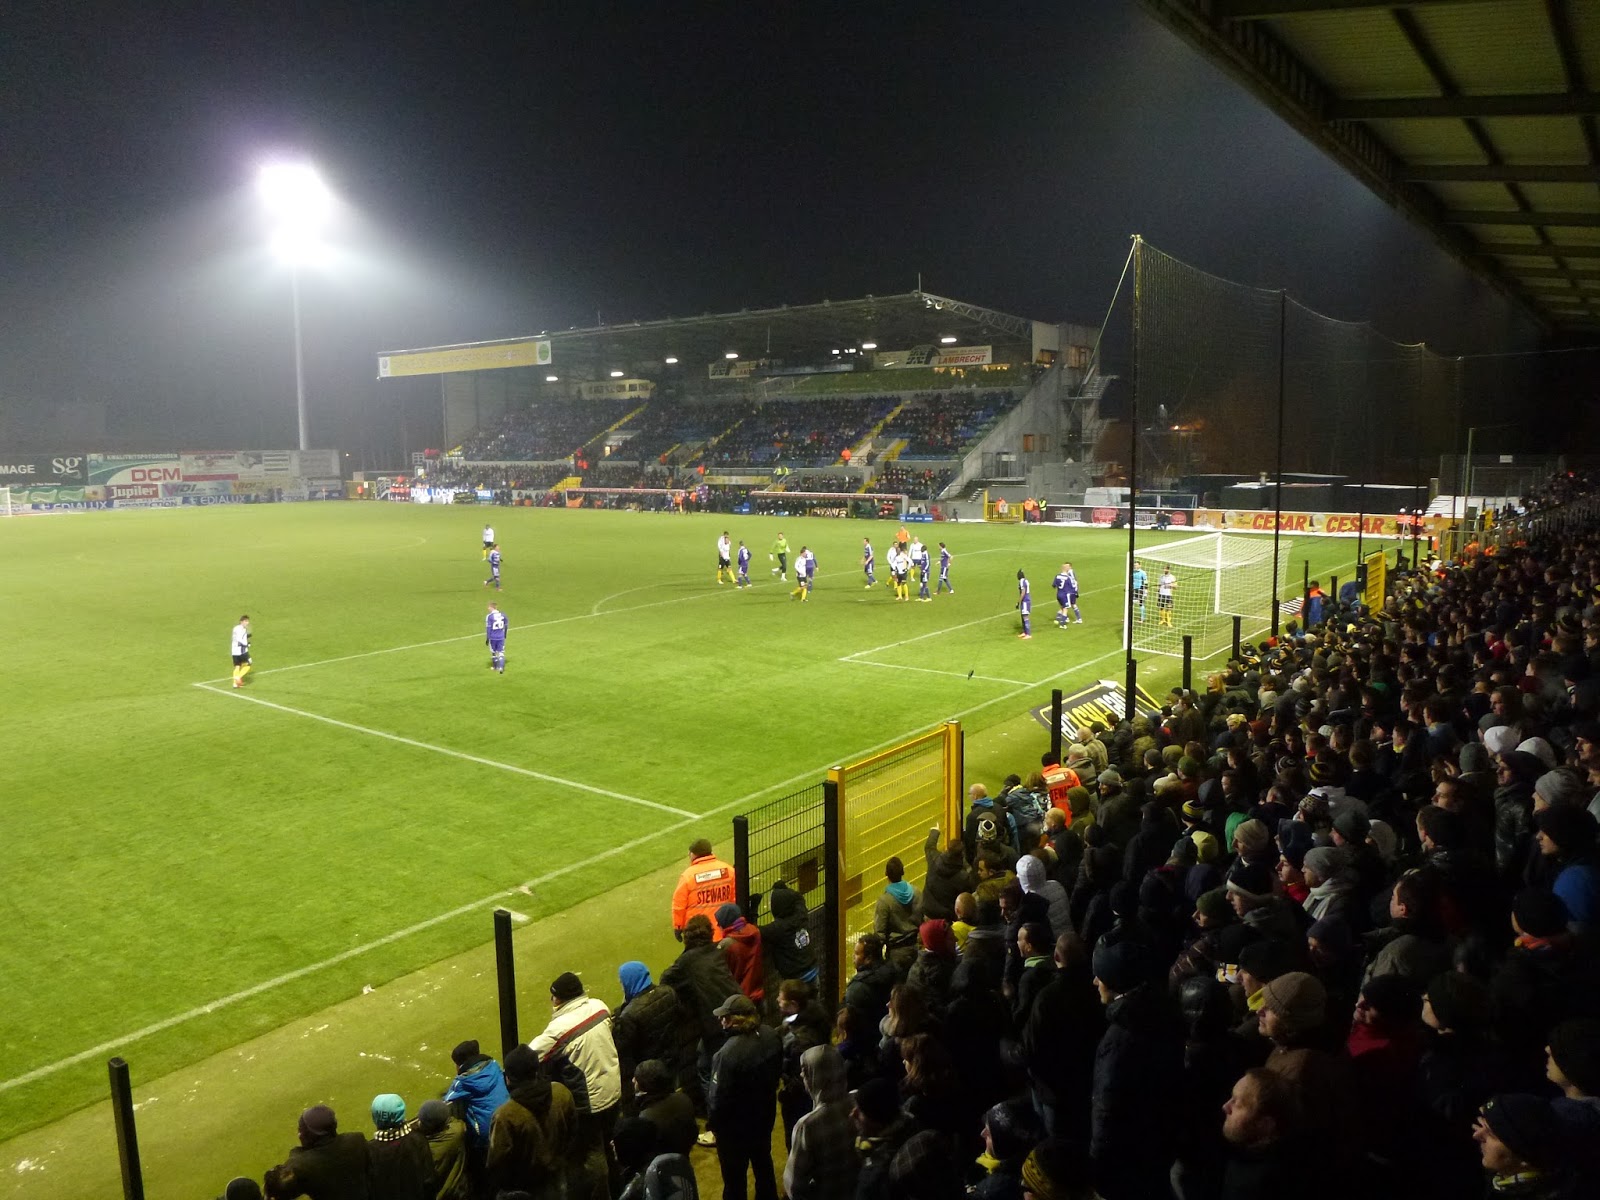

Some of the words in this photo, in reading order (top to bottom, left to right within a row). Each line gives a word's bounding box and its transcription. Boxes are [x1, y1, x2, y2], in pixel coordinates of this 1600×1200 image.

[938, 355, 986, 364] LAMBRECHT
[131, 467, 182, 482] DCM
[110, 485, 157, 499] Jupiler
[200, 495, 246, 505] EDIALUX
[1252, 513, 1308, 531] CESAR
[1326, 516, 1385, 534] CESAR
[696, 884, 731, 905] STEWARD
